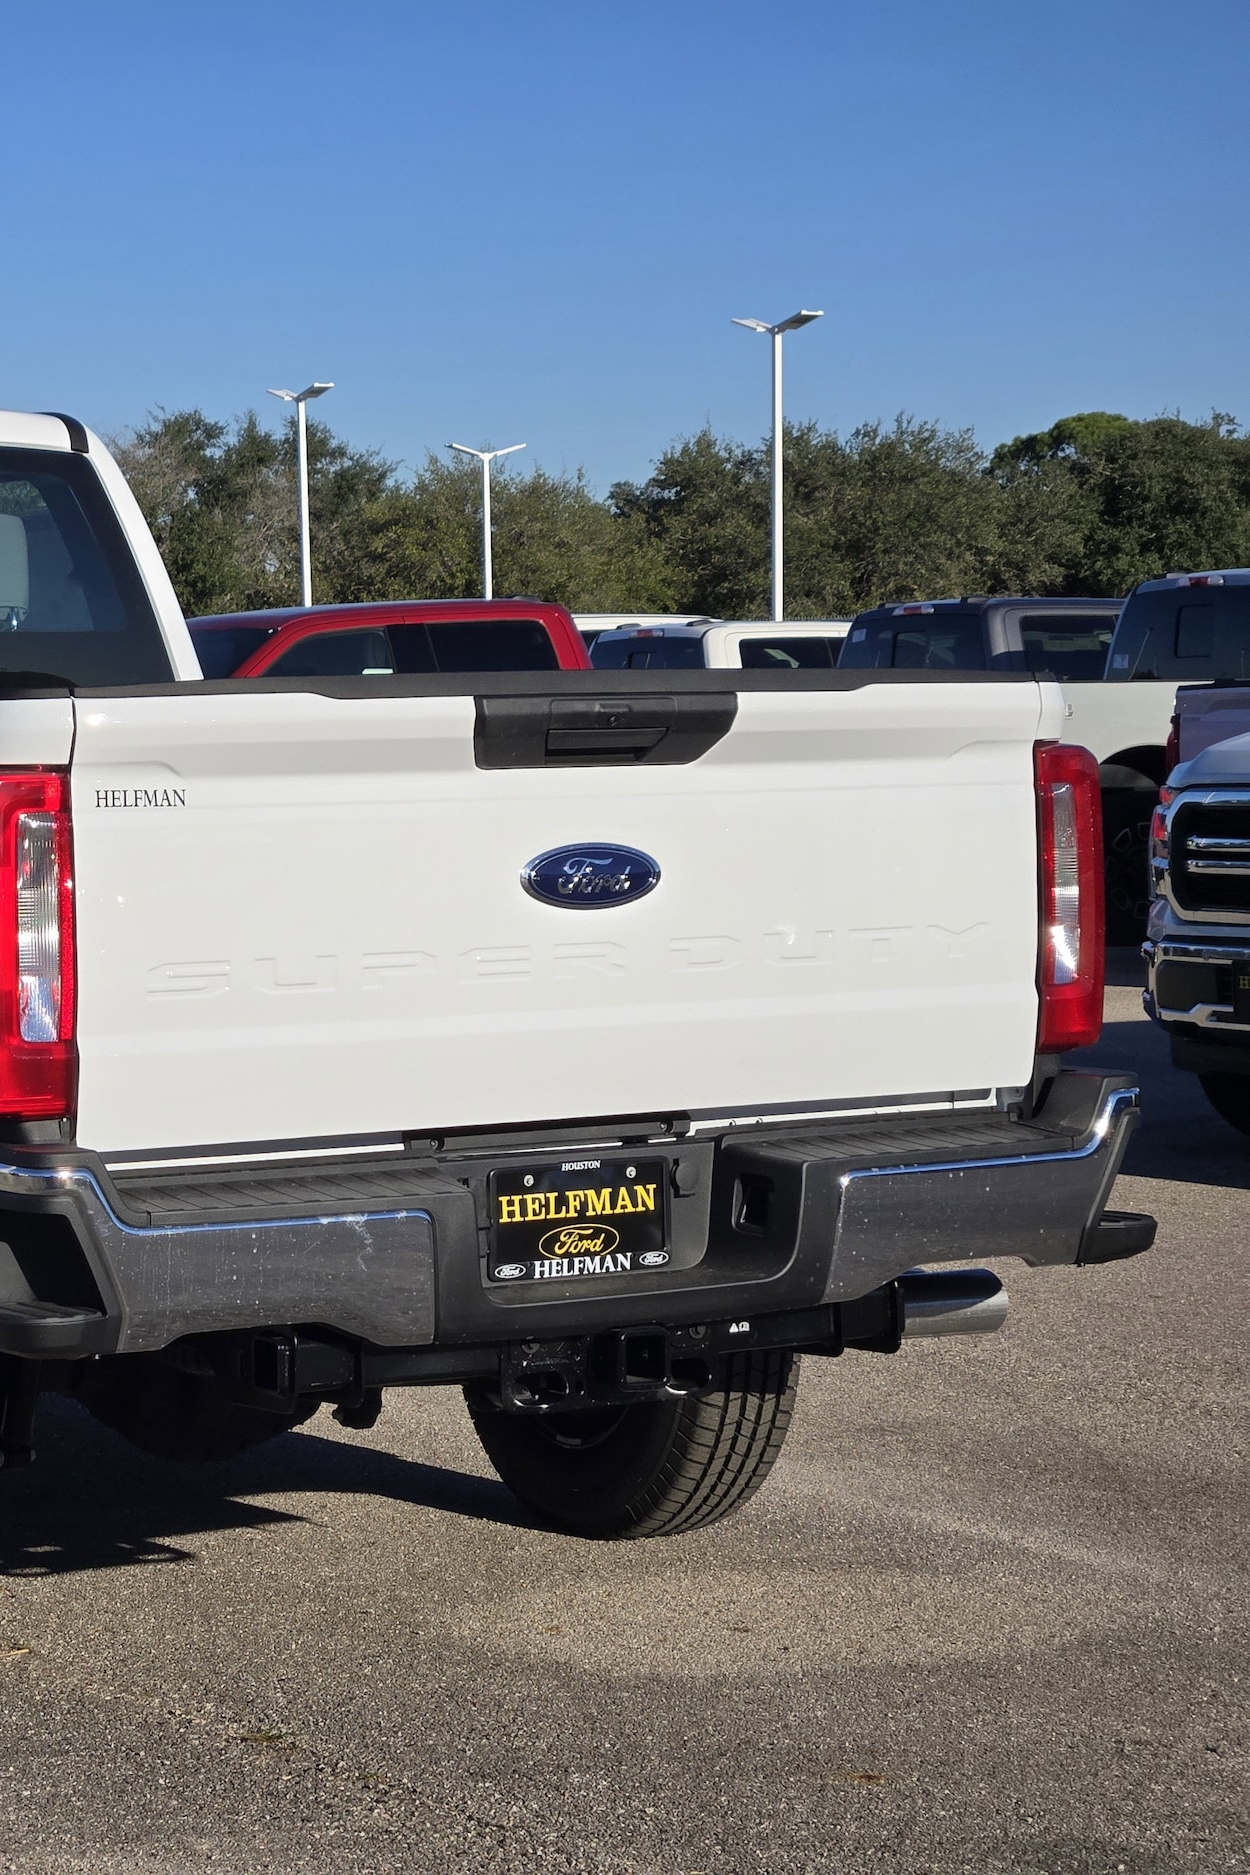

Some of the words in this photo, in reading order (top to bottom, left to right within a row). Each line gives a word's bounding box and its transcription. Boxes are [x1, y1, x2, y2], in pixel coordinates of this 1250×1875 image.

[95, 789, 186, 808] HELFMAN
[558, 857, 632, 894] Ford
[147, 940, 626, 1001] SUPER
[670, 921, 990, 974] DUTY
[561, 1160, 601, 1172] HOUSTON
[499, 1184, 657, 1223] HELFMAN
[554, 1228, 606, 1255] Ford
[534, 1252, 633, 1279] HELFMAN
